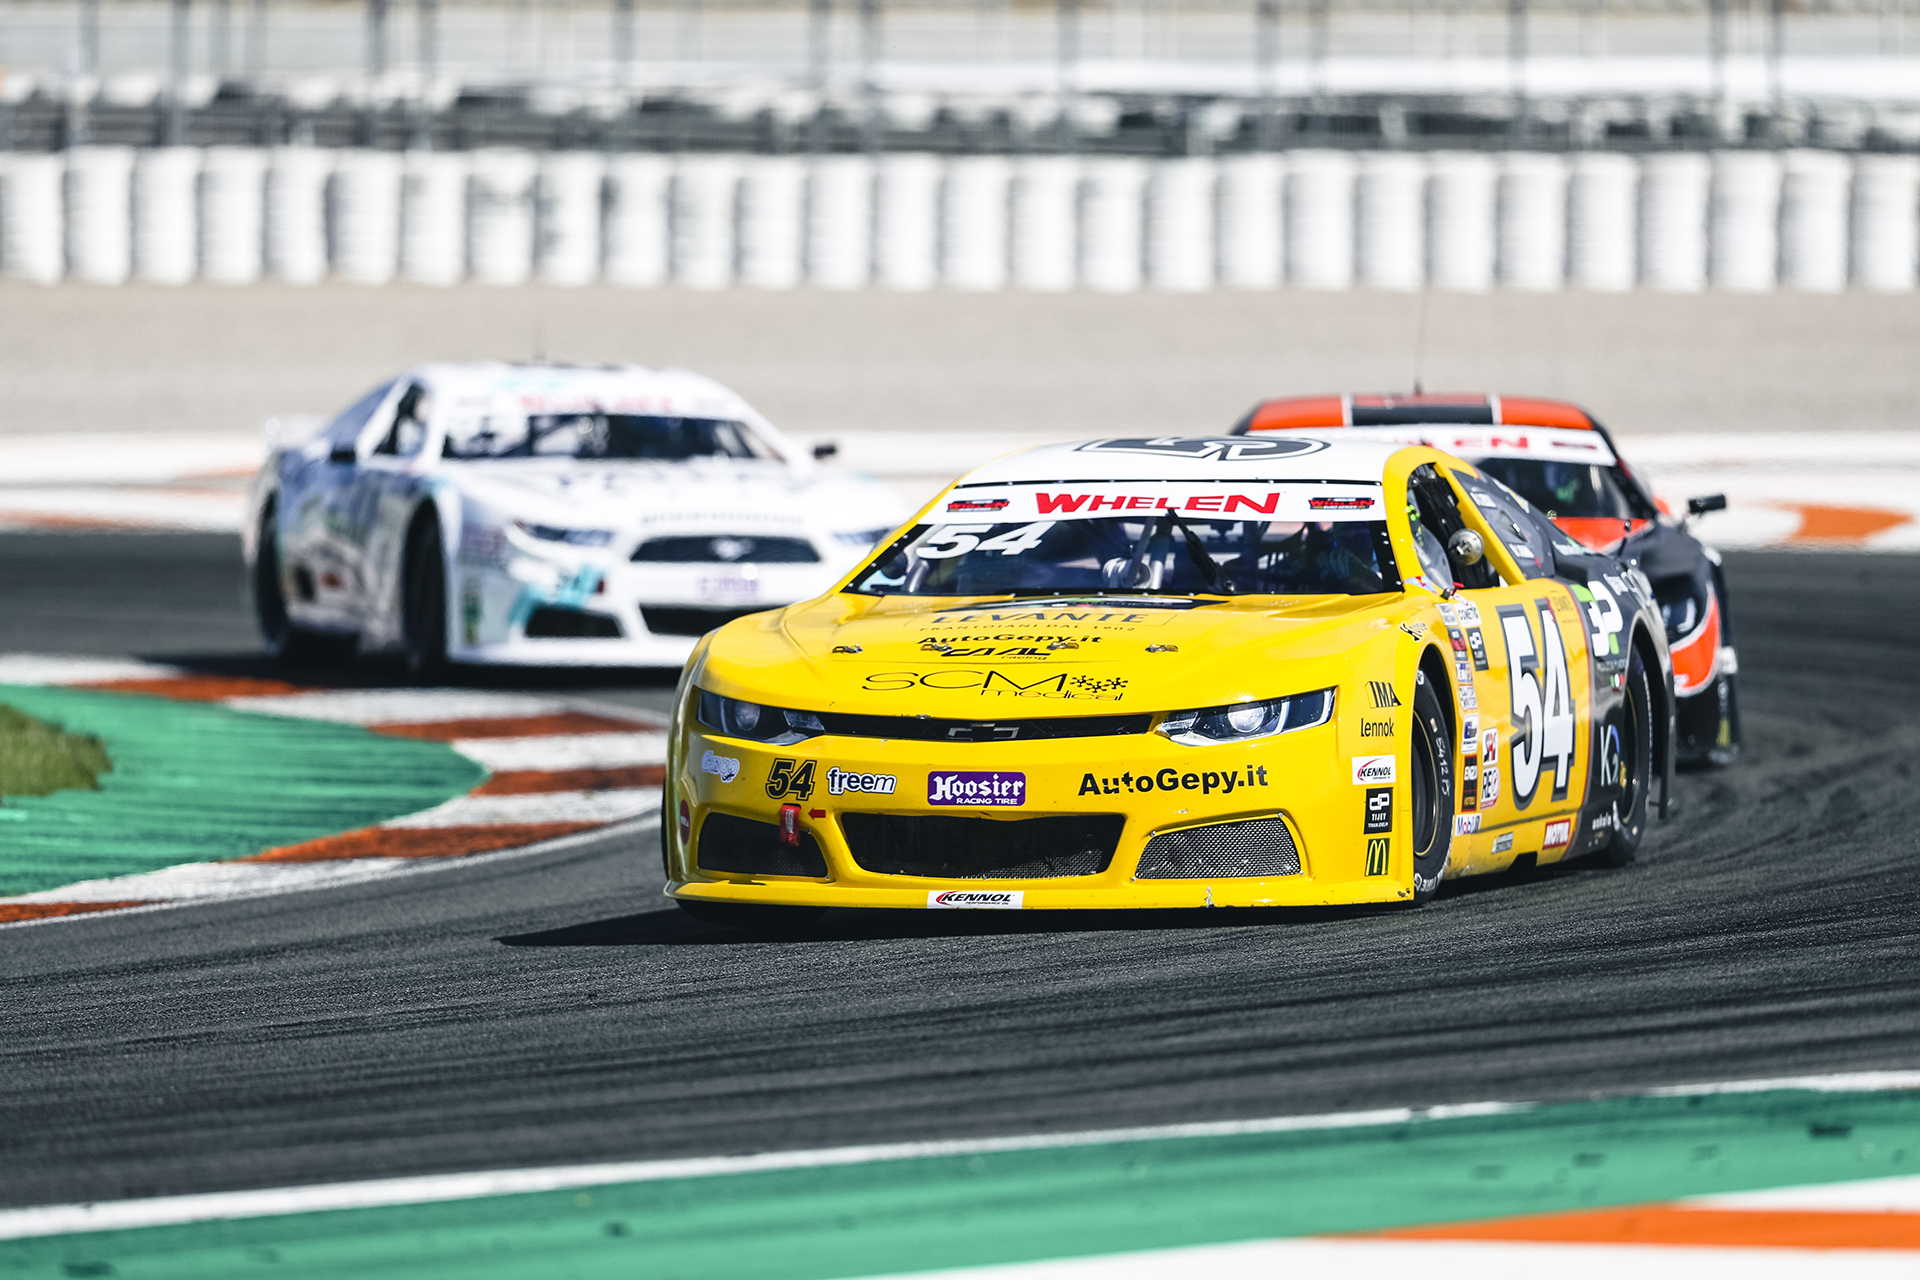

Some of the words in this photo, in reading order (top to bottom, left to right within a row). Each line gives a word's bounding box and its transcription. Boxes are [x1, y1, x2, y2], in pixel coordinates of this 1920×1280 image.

[1036, 492, 1280, 514] WHELEN
[916, 521, 1056, 559] 54
[932, 612, 1149, 624] LEVANTE
[917, 634, 1102, 644] AutoGepy.it
[862, 670, 1068, 692] SCM
[981, 689, 1124, 701] medical
[1365, 681, 1402, 708] IMA
[1498, 604, 1574, 803] 54
[1361, 717, 1394, 737] Lennok
[765, 758, 817, 801] 54
[828, 767, 896, 795] freem
[1078, 764, 1269, 796] AutoGepy.it
[1360, 766, 1392, 777] KENNOL
[928, 773, 1025, 801] Hoosier
[941, 893, 1012, 902] KENNOL
